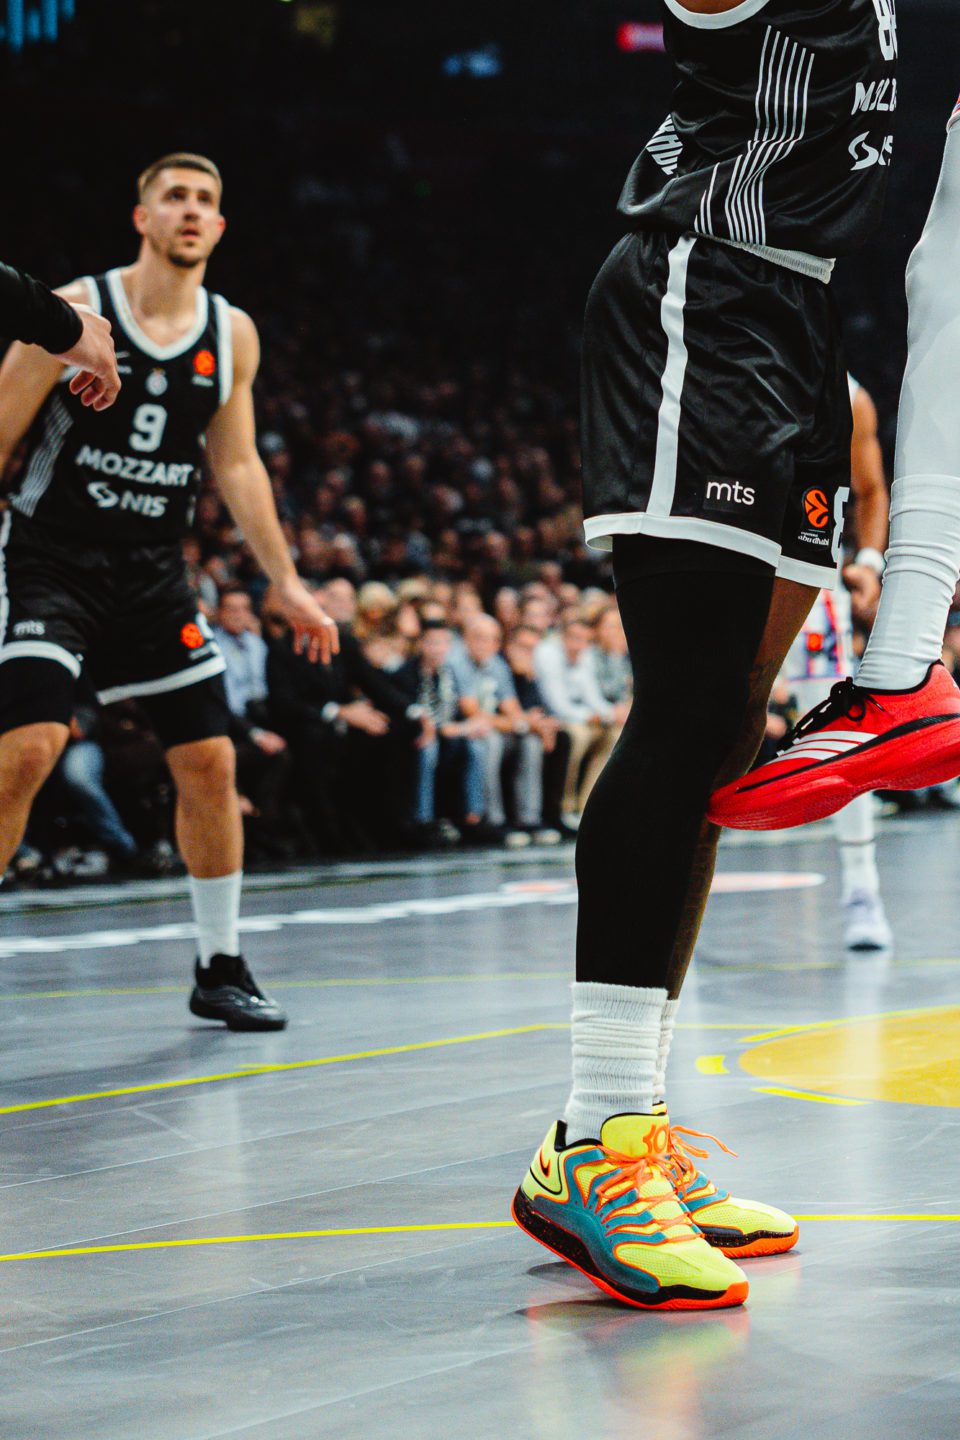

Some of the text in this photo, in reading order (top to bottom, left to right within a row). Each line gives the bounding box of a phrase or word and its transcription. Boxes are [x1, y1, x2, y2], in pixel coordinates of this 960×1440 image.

[129, 403, 168, 452] 9
[75, 445, 194, 486] MOZZART
[121, 491, 168, 517] NIS
[706, 481, 756, 505] mts
